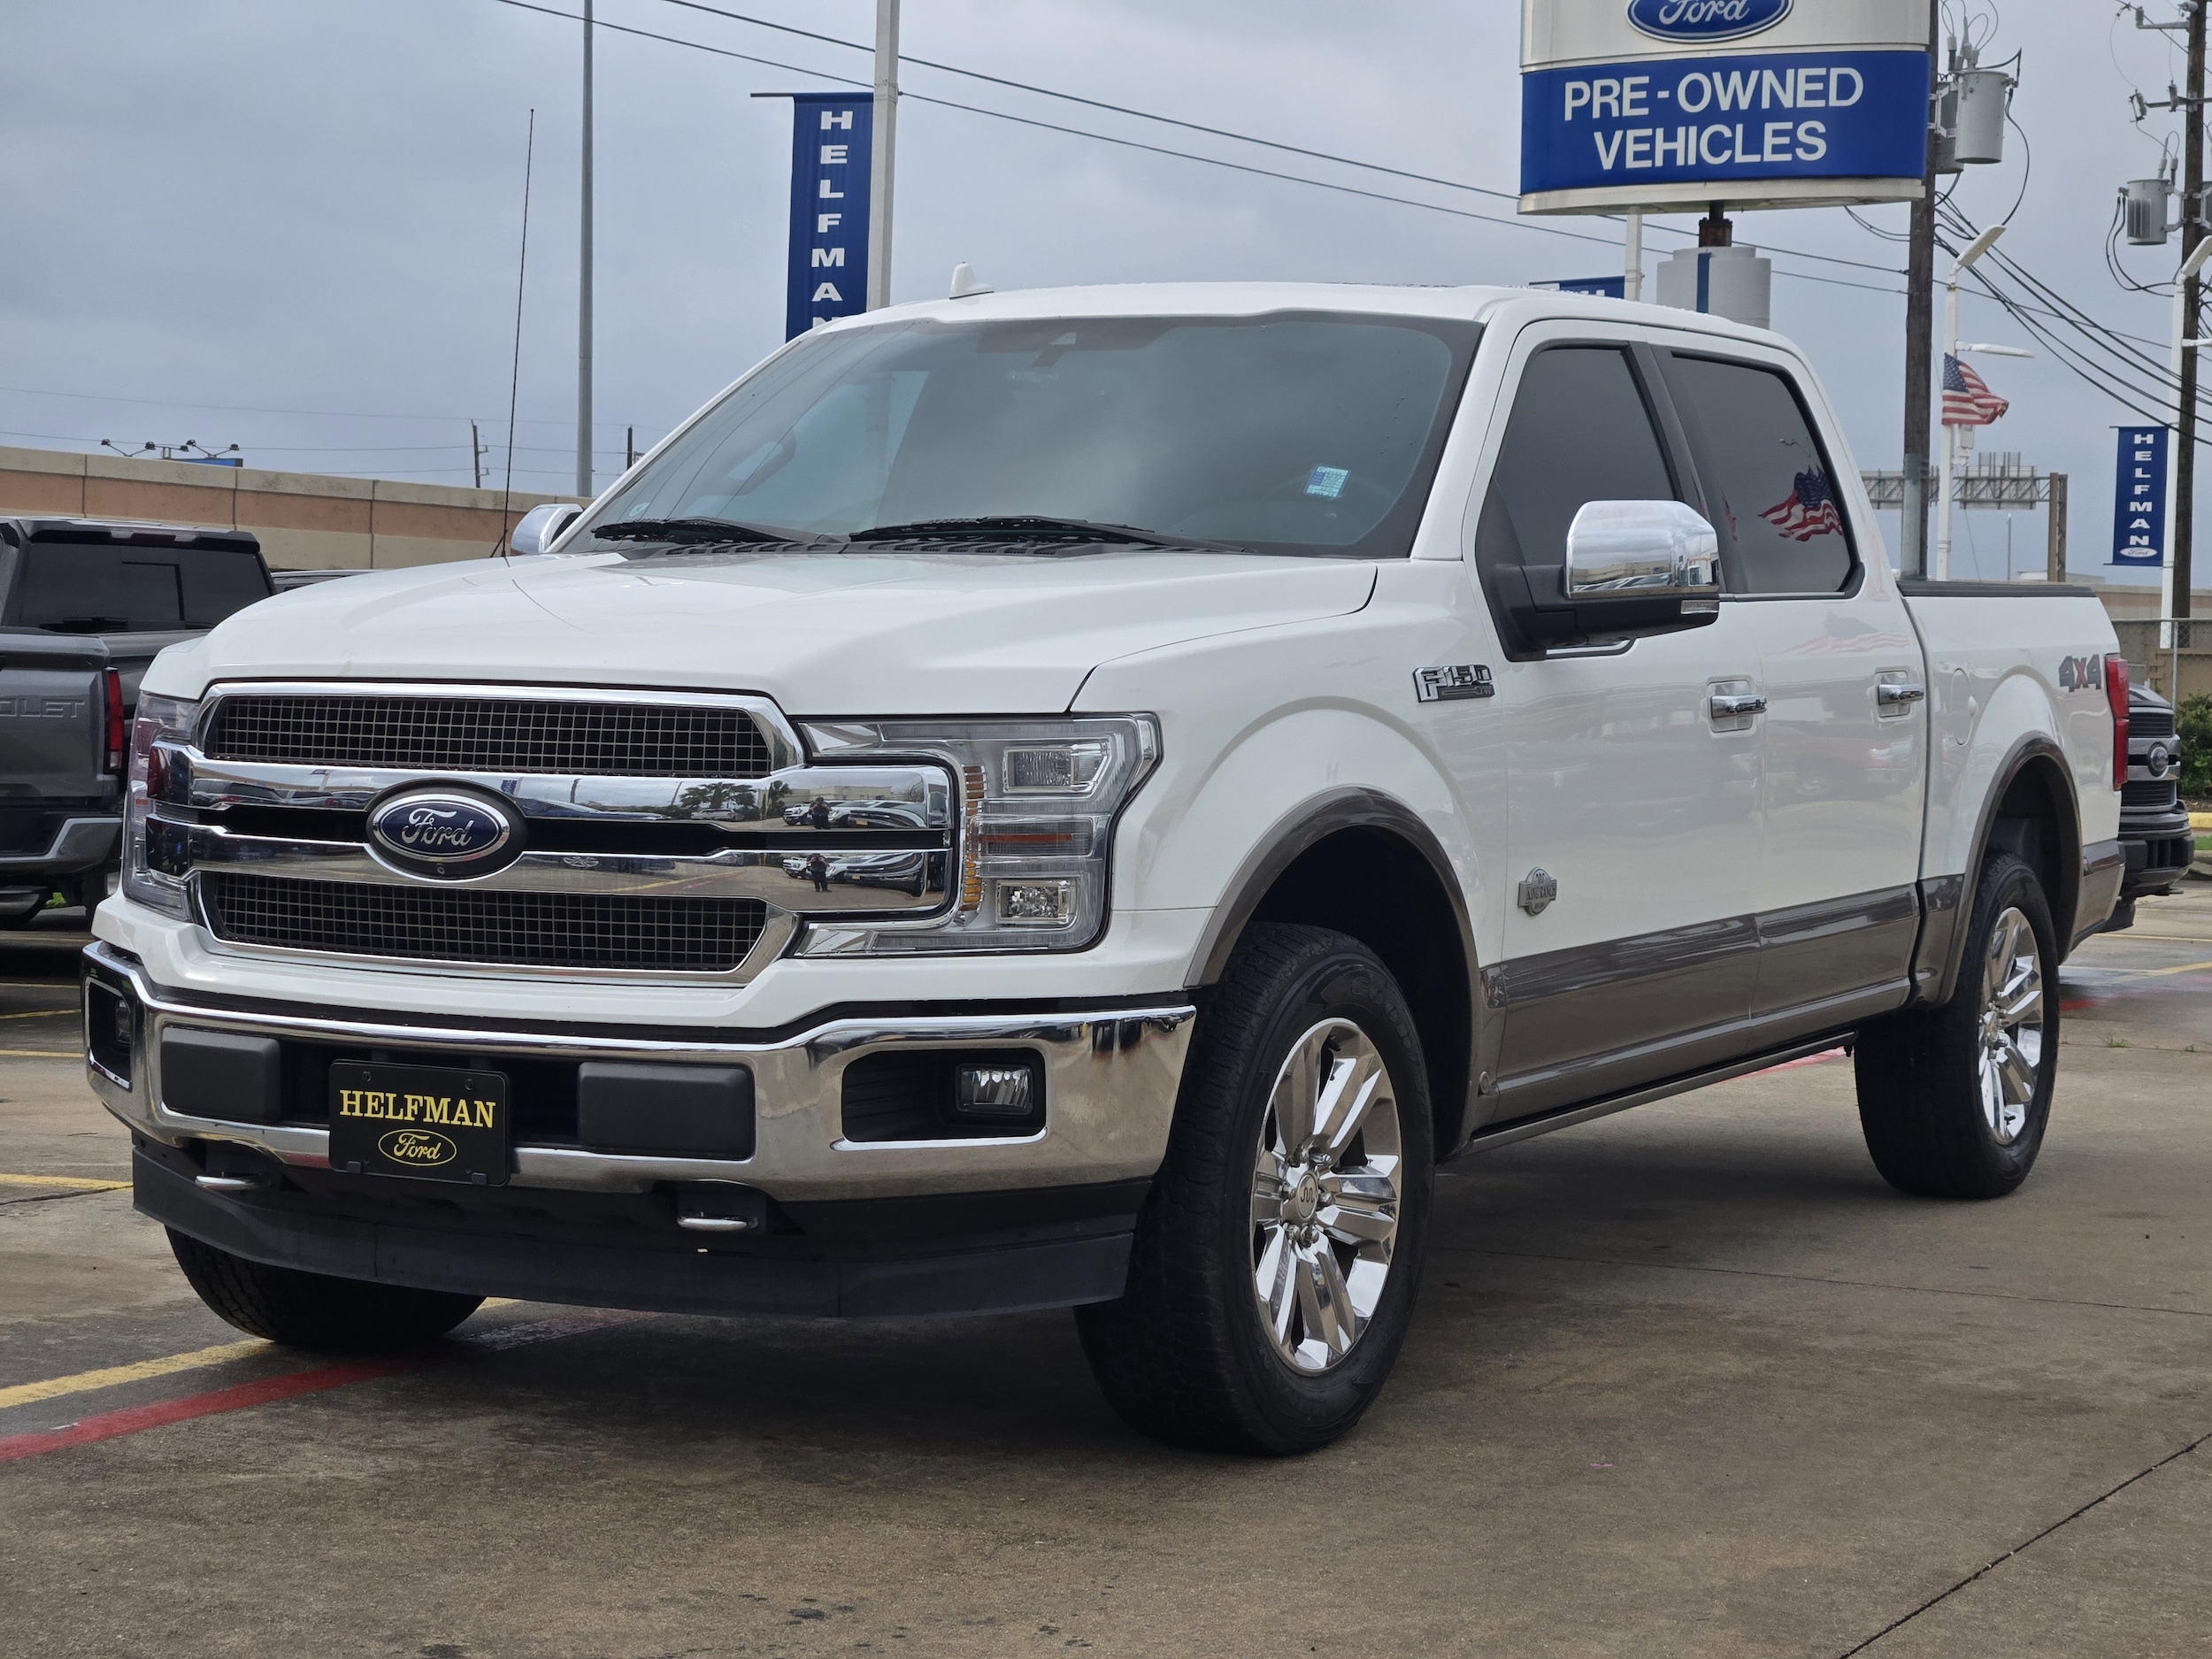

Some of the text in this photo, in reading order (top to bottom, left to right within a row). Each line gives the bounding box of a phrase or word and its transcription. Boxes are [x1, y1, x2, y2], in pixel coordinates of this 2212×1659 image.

[1594, 120, 1827, 170] VEHICLES
[2129, 434, 2154, 545] HELFMAN
[401, 807, 475, 847] Ford
[339, 1089, 496, 1128] HELFMAN
[393, 1132, 442, 1160] Ford
